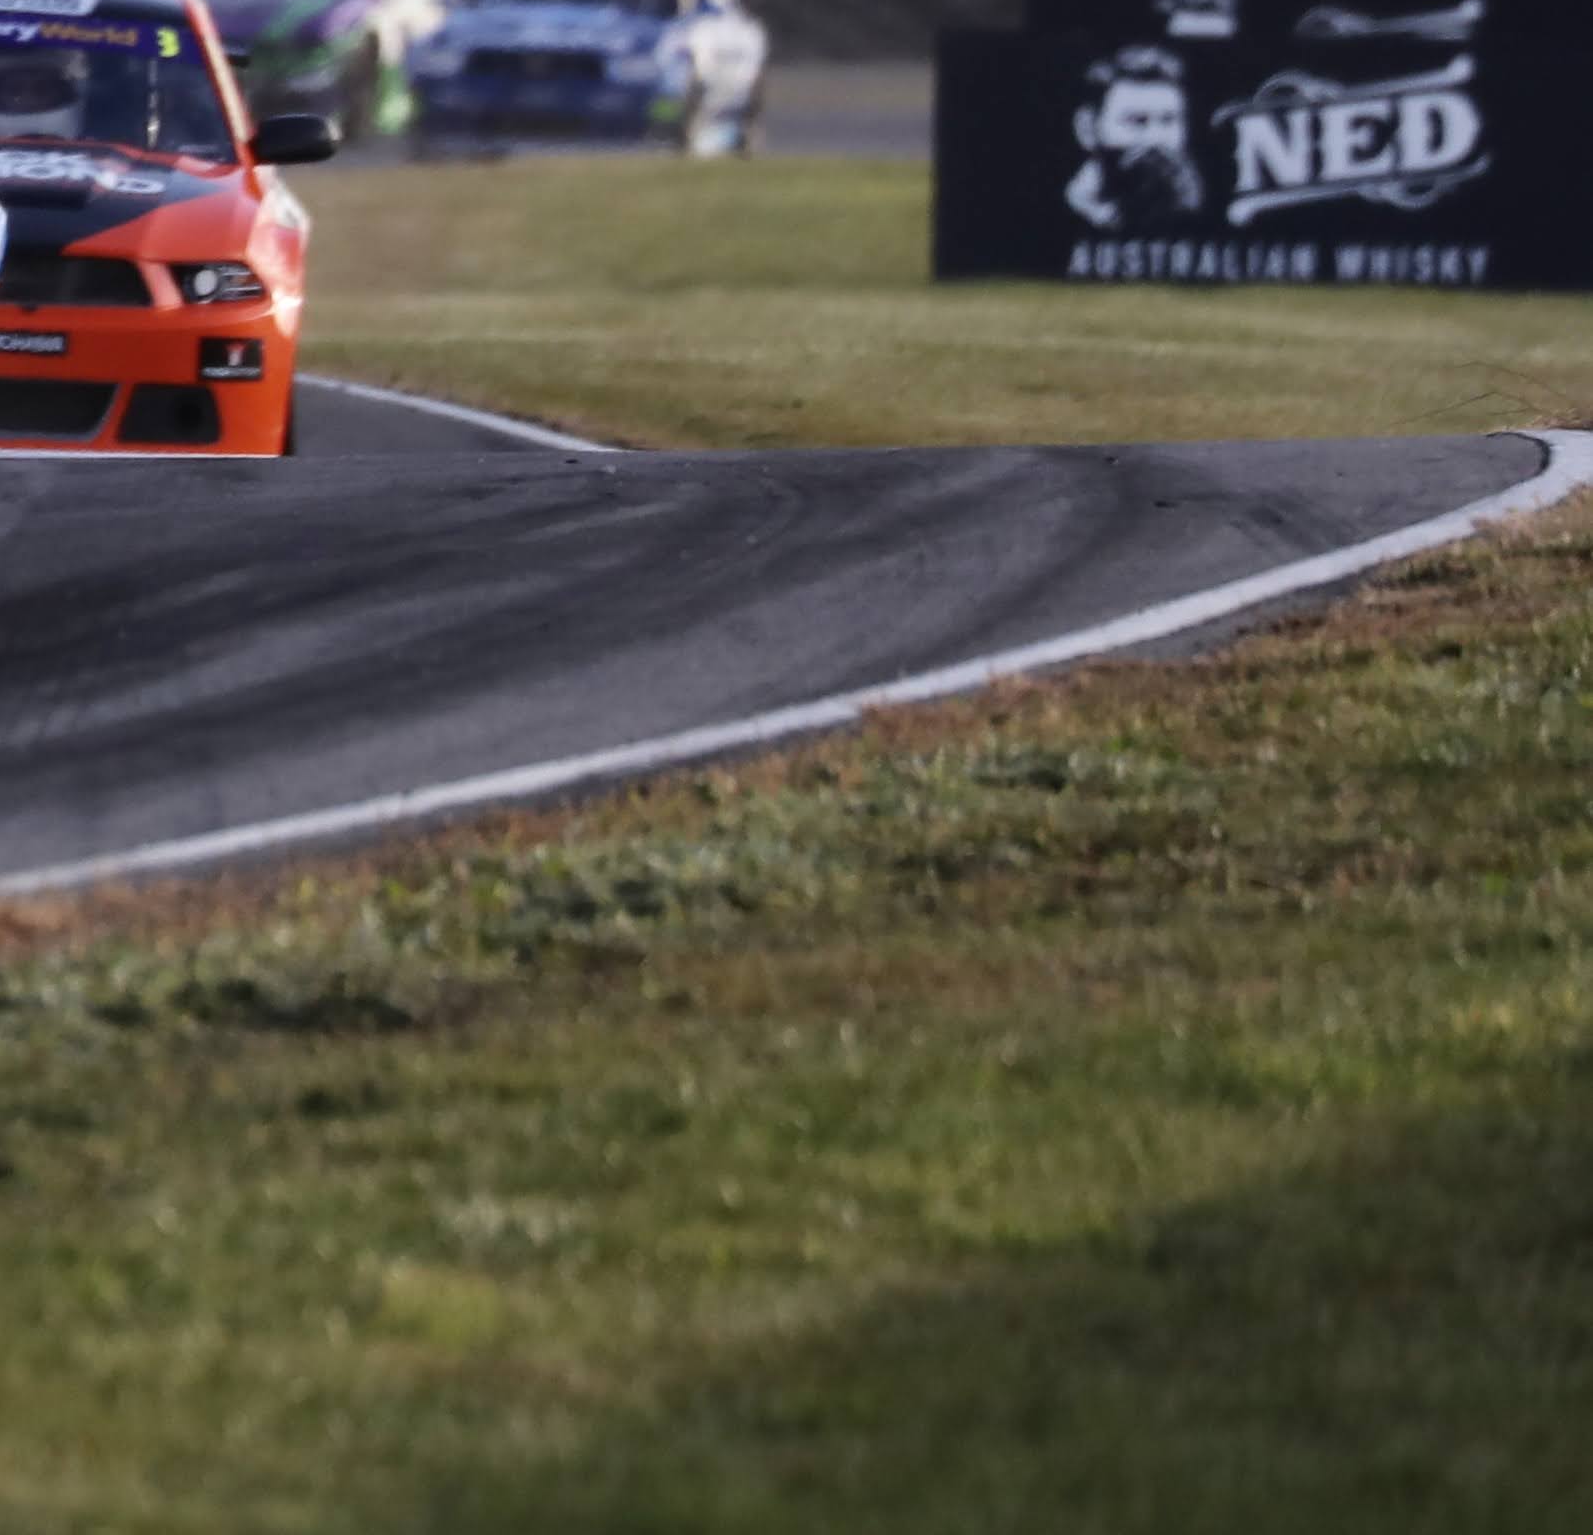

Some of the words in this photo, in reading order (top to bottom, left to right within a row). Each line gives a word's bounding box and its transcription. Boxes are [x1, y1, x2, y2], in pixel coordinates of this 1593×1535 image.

[156, 26, 180, 58] 3
[1233, 90, 1482, 194] NED
[1067, 241, 1317, 281] AUSTRALIAN
[1334, 244, 1489, 282] WHISKY
